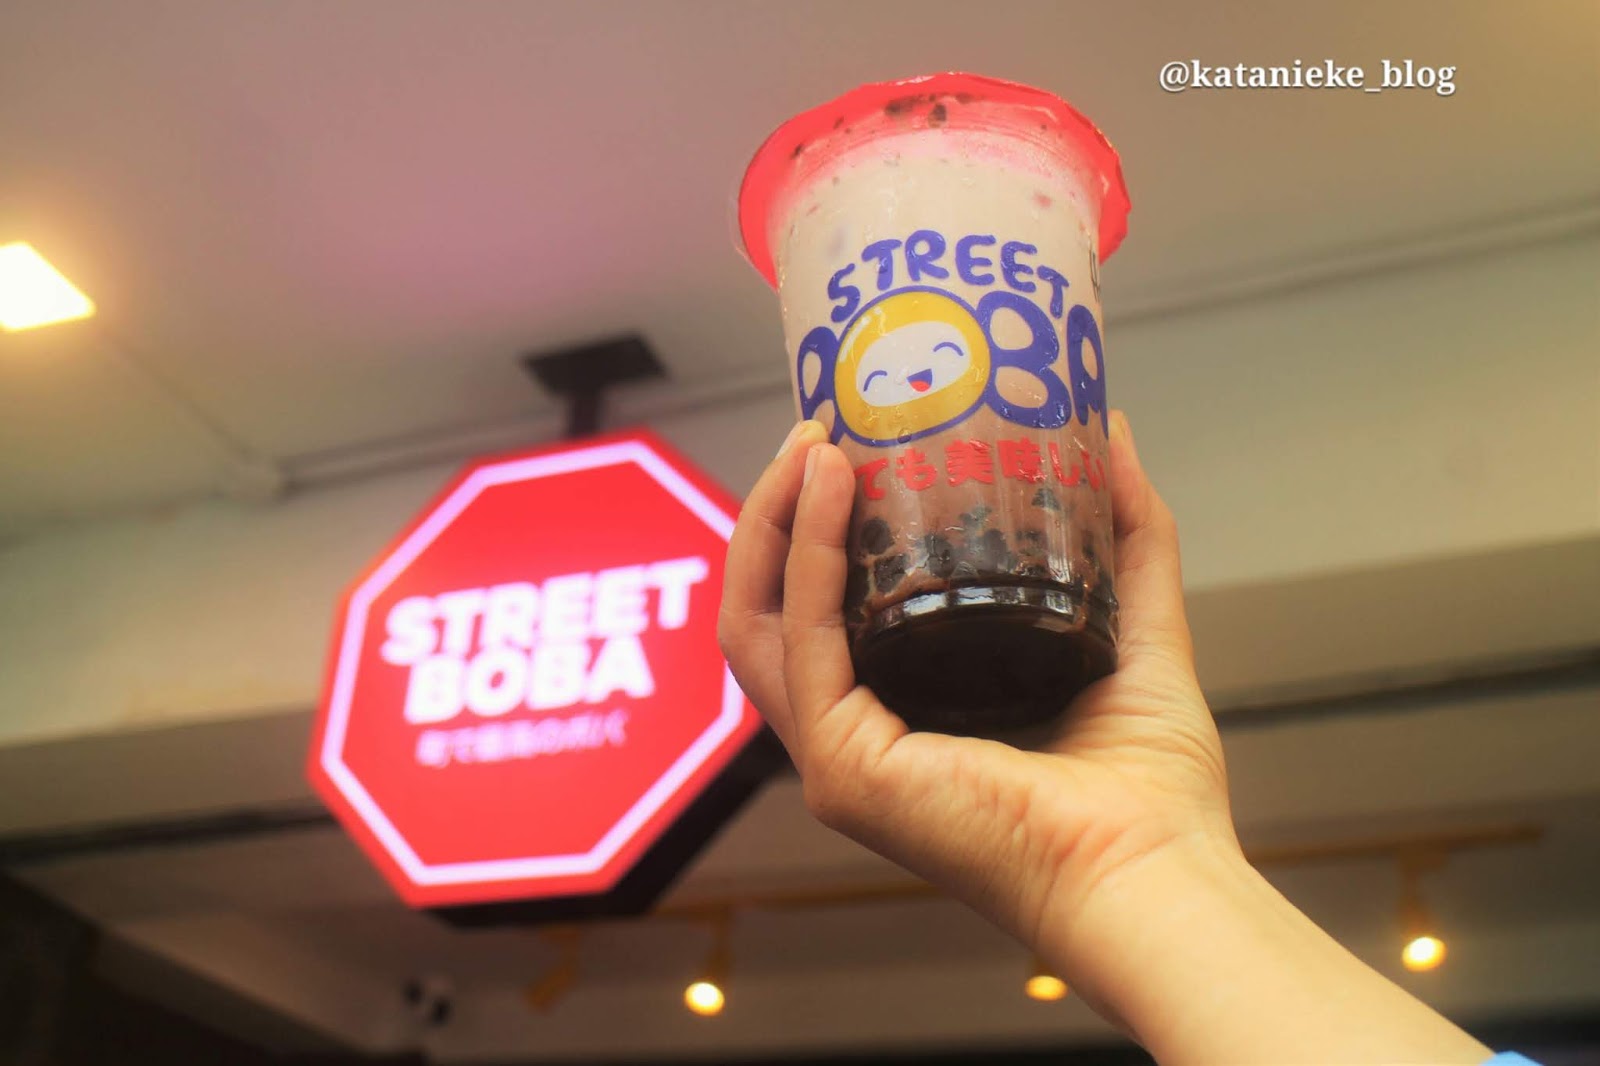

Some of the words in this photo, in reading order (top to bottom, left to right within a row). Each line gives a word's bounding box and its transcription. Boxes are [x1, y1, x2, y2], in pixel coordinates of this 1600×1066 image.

[827, 229, 1069, 322] STREET
[380, 556, 709, 665] STREET
[403, 633, 655, 724] BOBA
